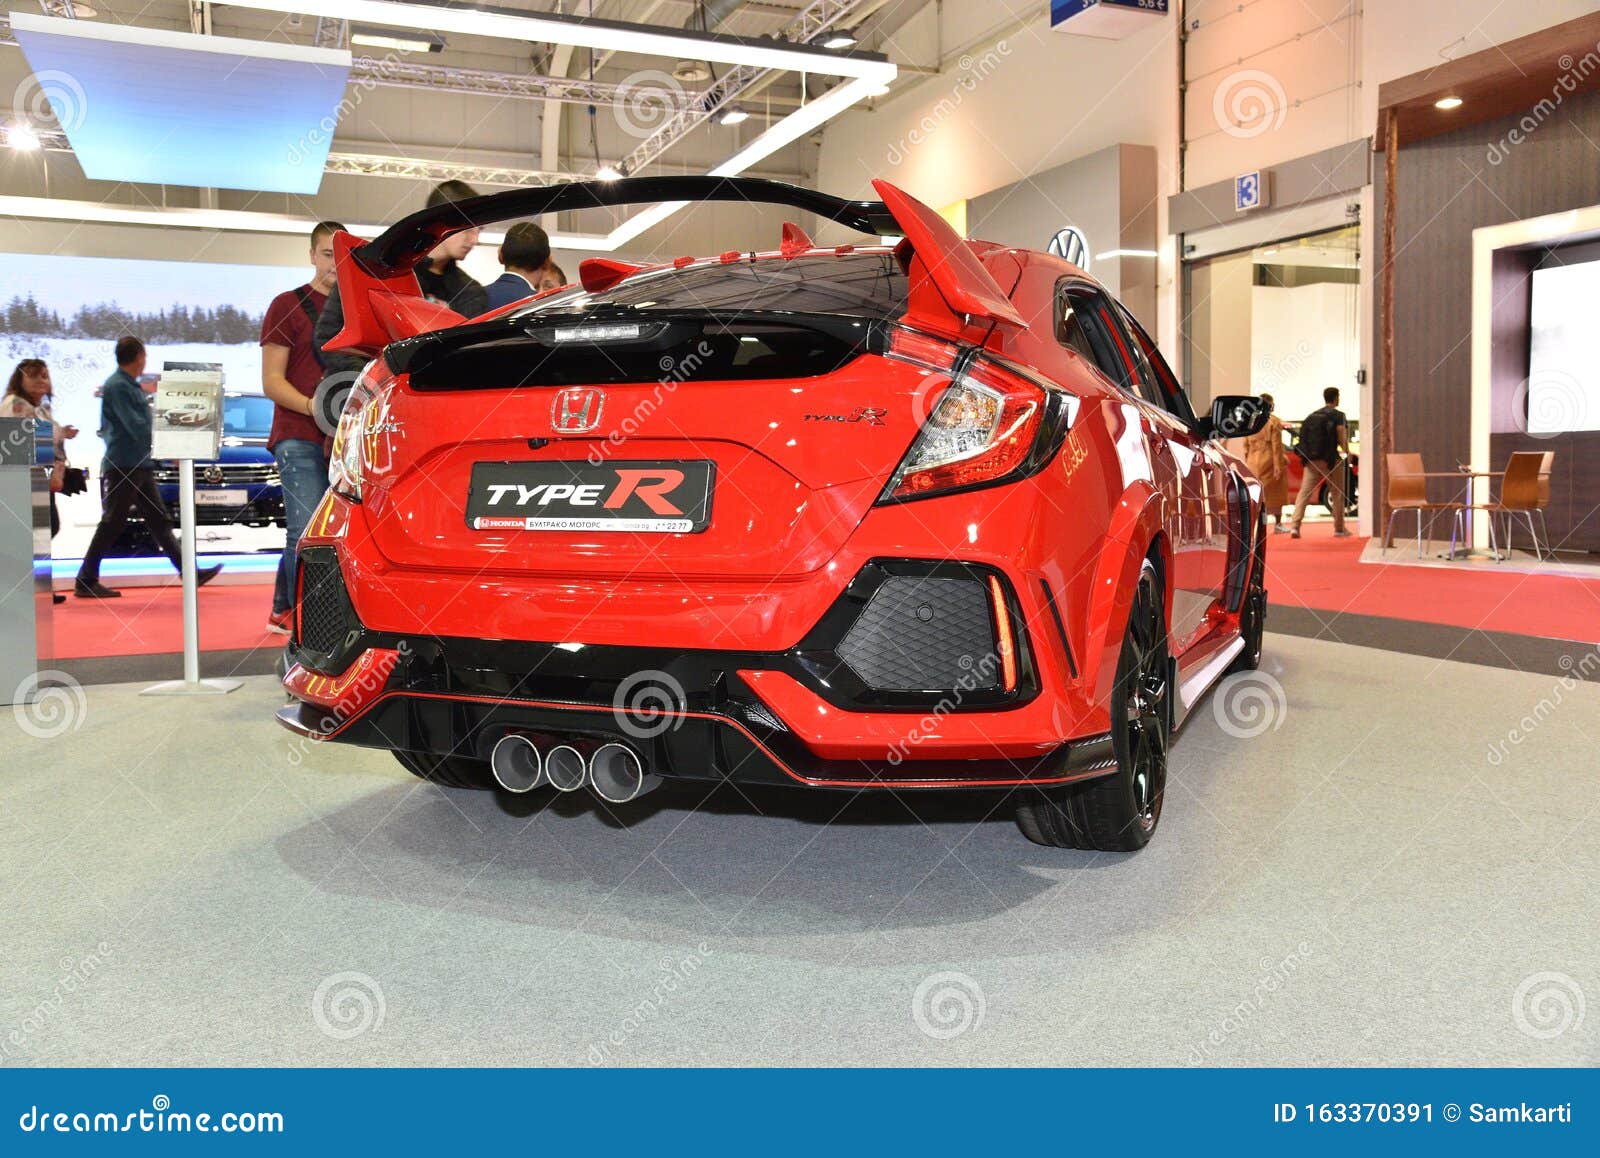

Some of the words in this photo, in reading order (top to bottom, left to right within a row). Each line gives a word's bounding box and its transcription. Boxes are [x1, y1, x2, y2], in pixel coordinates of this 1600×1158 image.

[1242, 175, 1257, 206] 3
[486, 484, 606, 506] TYPE
[603, 469, 685, 515] R
